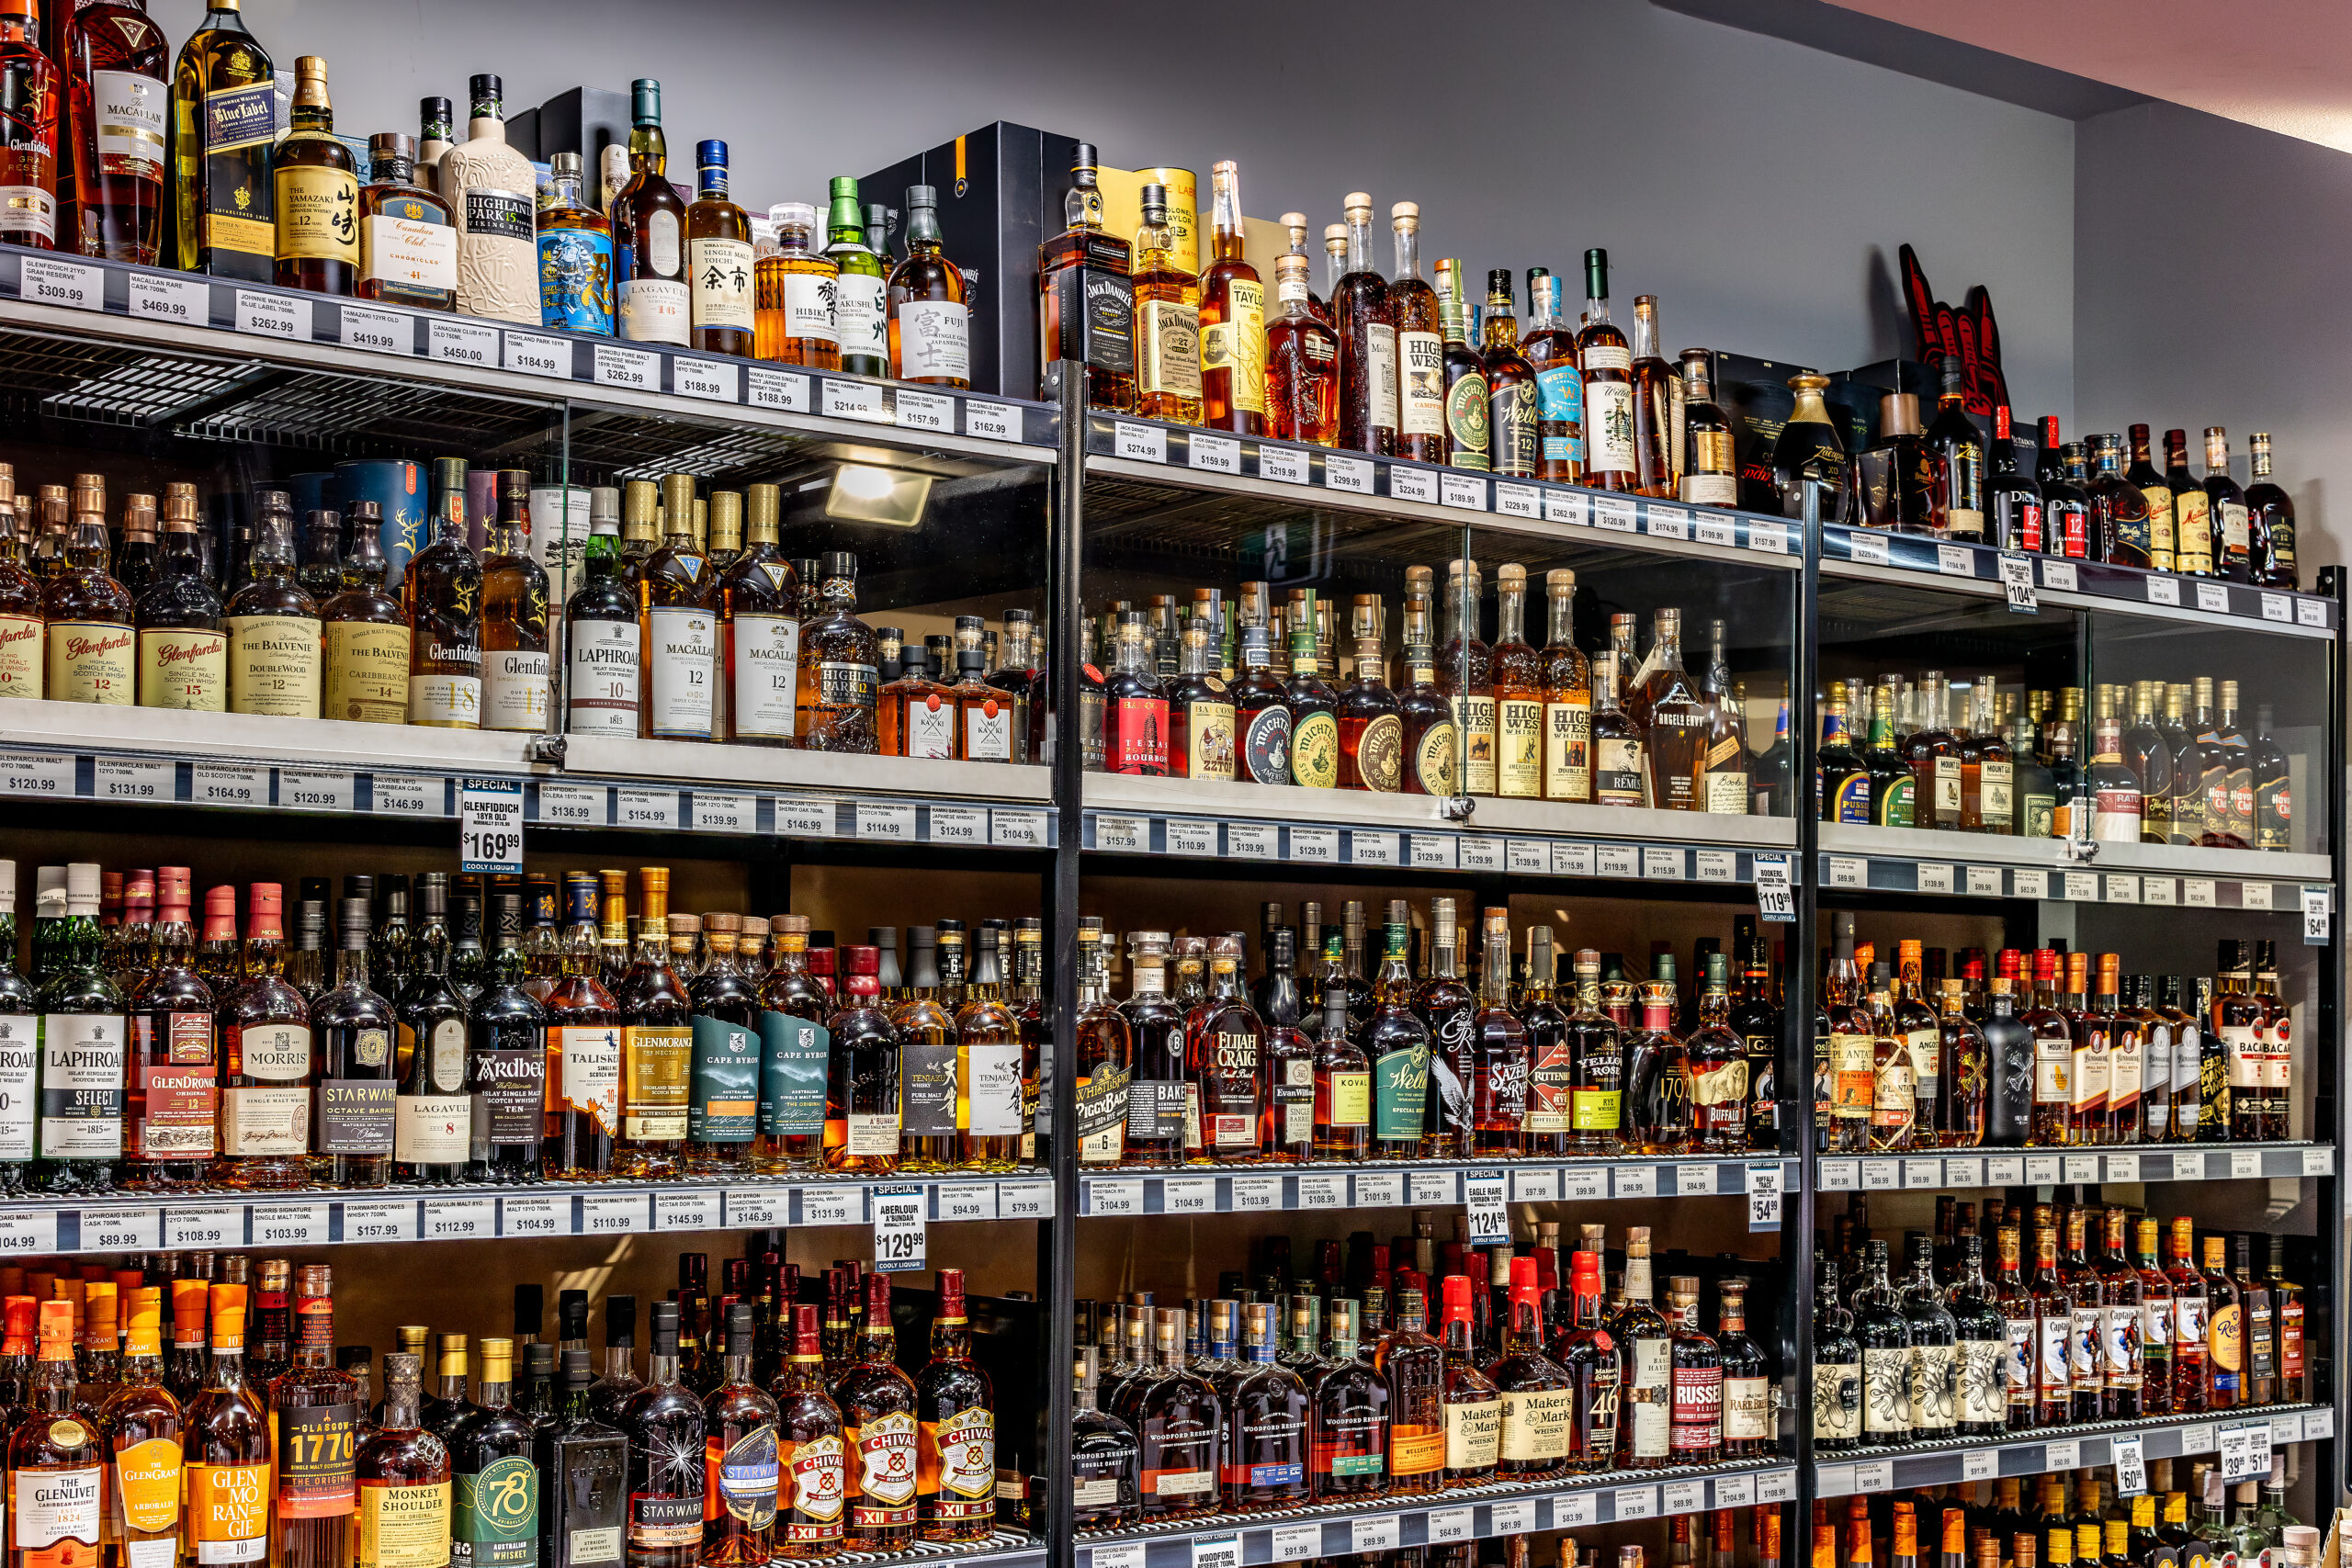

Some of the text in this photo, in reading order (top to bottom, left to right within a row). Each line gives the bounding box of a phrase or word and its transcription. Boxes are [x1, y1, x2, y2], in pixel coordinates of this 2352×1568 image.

[107, 105, 162, 124] MACALLAN
[241, 101, 267, 118] Label
[288, 195, 334, 204] YAMAZAKI
[468, 197, 532, 217] HIGHLAND
[299, 215, 311, 225] 12
[27, 268, 74, 280] GRAN RESERVE
[38, 285, 83, 300] $309.99
[142, 299, 186, 315] $469.99
[797, 308, 826, 317] HIBIKI
[252, 316, 293, 333] $262.99
[944, 316, 964, 326] FUJI
[354, 333, 393, 347] $419.99
[1179, 338, 1188, 346] 27
[444, 346, 482, 360] $450.00
[517, 355, 555, 369] $184.99
[607, 370, 643, 383] $262.99
[684, 380, 719, 394] $188.99
[758, 392, 791, 405] $188.99
[907, 413, 939, 425] $157.99
[975, 422, 1005, 434] $162.99
[1127, 444, 1156, 456] $274.99
[1202, 456, 1229, 468] $159.99
[1270, 467, 1296, 478] $219.99
[1334, 476, 1360, 487] $299.99
[1399, 485, 1425, 496] $224.99
[1505, 502, 1529, 512] $229.99
[1603, 516, 1625, 527] $120.99
[2027, 510, 2039, 526] 12
[2070, 518, 2083, 533] 12
[1702, 530, 1723, 539] $199.99
[1755, 537, 1776, 547] $157.99
[66, 632, 131, 660] Glenfarclas
[688, 671, 703, 683] 12
[773, 675, 786, 688] 12
[10, 777, 55, 790] $120.99
[468, 780, 513, 791] SPECIAL
[1614, 777, 1641, 789] REMUS
[109, 783, 153, 795] $131.99
[208, 786, 250, 799] $164.99
[294, 792, 335, 804] $120.99
[384, 798, 424, 809] $146.99
[464, 801, 518, 814] GLENFIDDICH
[551, 807, 589, 818] $136.99
[628, 810, 664, 821] $154.99
[702, 815, 737, 826] $139.99
[787, 819, 820, 830] $146.99
[867, 823, 899, 834] $114.99
[941, 826, 972, 837] $124.99
[1002, 829, 1034, 840] $104.99
[1106, 837, 1136, 847] $157.99
[1177, 840, 1205, 851] $110.99
[1237, 842, 1264, 852] $139.99
[1299, 846, 1326, 856] $129.99
[1360, 850, 1385, 859] $129.99
[1516, 858, 1539, 868] $139.99
[1560, 861, 1583, 870] $115.99
[1604, 863, 1627, 872] $119.99
[1705, 868, 1726, 876] $109.99
[1760, 869, 1782, 878] BOOKERS
[1838, 874, 1855, 884] $89.99
[1217, 1031, 1257, 1049] ELIJAH
[250, 1053, 305, 1065] MORRIS
[777, 1051, 801, 1059] CAPE
[979, 1074, 1011, 1082] TENJAKU
[1340, 1079, 1368, 1088] KOVAL
[75, 1091, 113, 1106] SELECT
[1710, 1107, 1739, 1122] BUFFALO
[87, 1124, 103, 1134] 1815
[446, 1122, 454, 1134] 8
[1871, 1177, 1889, 1185] $89.99
[878, 1186, 918, 1194] SPECIAL
[1468, 1188, 1486, 1196] EAGLE
[1525, 1188, 1546, 1197] $97.99
[1576, 1186, 1596, 1195] $99.99
[1623, 1183, 1643, 1192] $86.99
[1175, 1198, 1203, 1208] $104.99
[1241, 1195, 1269, 1205] $103.99
[1308, 1194, 1335, 1204] $108.99
[880, 1204, 919, 1214] ABERLOUR
[953, 1205, 979, 1214] $94.99
[1012, 1203, 1038, 1213] $79.99
[1101, 1200, 1129, 1210] $104.99
[668, 1214, 703, 1224] $145.99
[738, 1212, 772, 1223] $146.99
[812, 1209, 845, 1219] $131.99
[435, 1221, 474, 1232] $112.99
[516, 1218, 554, 1230] $104.99
[594, 1217, 629, 1228] $110.99
[177, 1230, 220, 1241] $108.99
[266, 1228, 307, 1239] $103.99
[357, 1225, 397, 1236] $157.99
[99, 1235, 137, 1246] $89.99
[1526, 1397, 1571, 1410] Maker's
[1461, 1409, 1501, 1422] Maker's
[1541, 1412, 1570, 1423] Mark
[302, 1423, 349, 1432] GLASGOW
[949, 1429, 992, 1444] CHIVAS
[1150, 1429, 1218, 1441] WOODFORD RESERVE
[870, 1435, 916, 1450] CHIVAS
[1468, 1437, 1497, 1445] WHISKY
[291, 1432, 354, 1462] 1770
[803, 1457, 843, 1470] CHIVAS
[61, 1479, 79, 1487] THE
[213, 1471, 258, 1487] GLEN
[1862, 1479, 1880, 1487] $65.99
[35, 1485, 95, 1501] GLENLIVET
[230, 1487, 258, 1503] MO
[388, 1487, 439, 1500] MONKEY
[1724, 1493, 1746, 1503] $104.99
[1764, 1487, 1786, 1498] $108.99
[382, 1498, 442, 1512] SHOULDER
[1625, 1506, 1645, 1515] $78.99
[213, 1507, 249, 1521] RAN
[944, 1505, 965, 1517] XII
[864, 1512, 885, 1524] XII
[1563, 1513, 1583, 1523] $83.99
[228, 1520, 254, 1537] GIE
[1500, 1520, 1521, 1530] $61.99
[797, 1528, 817, 1540] XII
[1440, 1528, 1461, 1538] $64.99
[493, 1542, 526, 1551] AUSTRALIAN
[1363, 1536, 1385, 1546] $89.99
[493, 1550, 526, 1559] WHISKEY
[1285, 1545, 1308, 1556] $91.99
